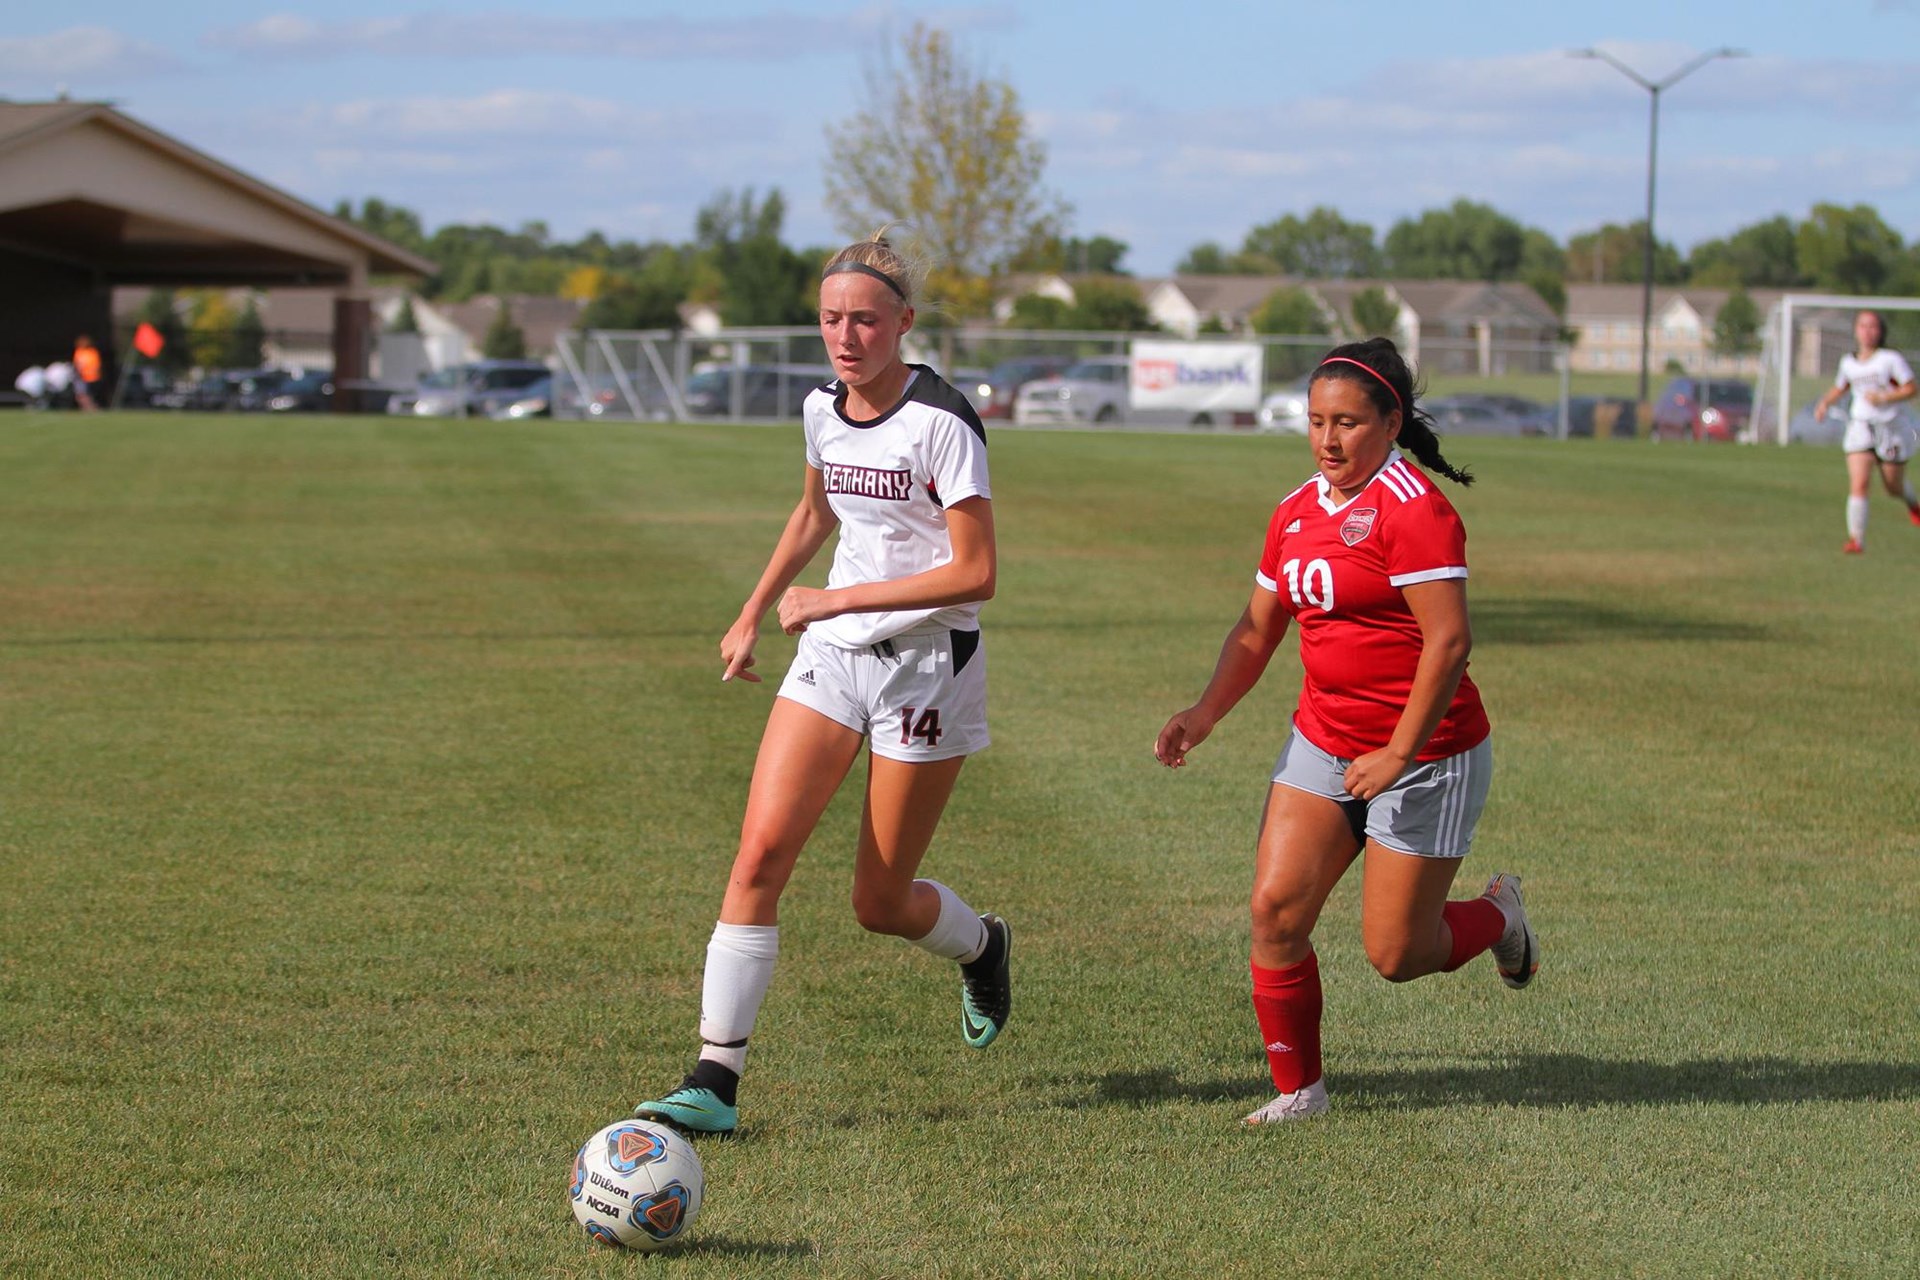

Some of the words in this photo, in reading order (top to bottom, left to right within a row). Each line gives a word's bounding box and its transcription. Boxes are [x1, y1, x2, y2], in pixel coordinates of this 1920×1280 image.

[1176, 362, 1248, 384] bank
[823, 463, 911, 500] BETHANY
[1282, 558, 1334, 612] 10
[900, 706, 942, 746] 14
[590, 1171, 630, 1200] Wilson
[586, 1195, 620, 1219] NCAA
